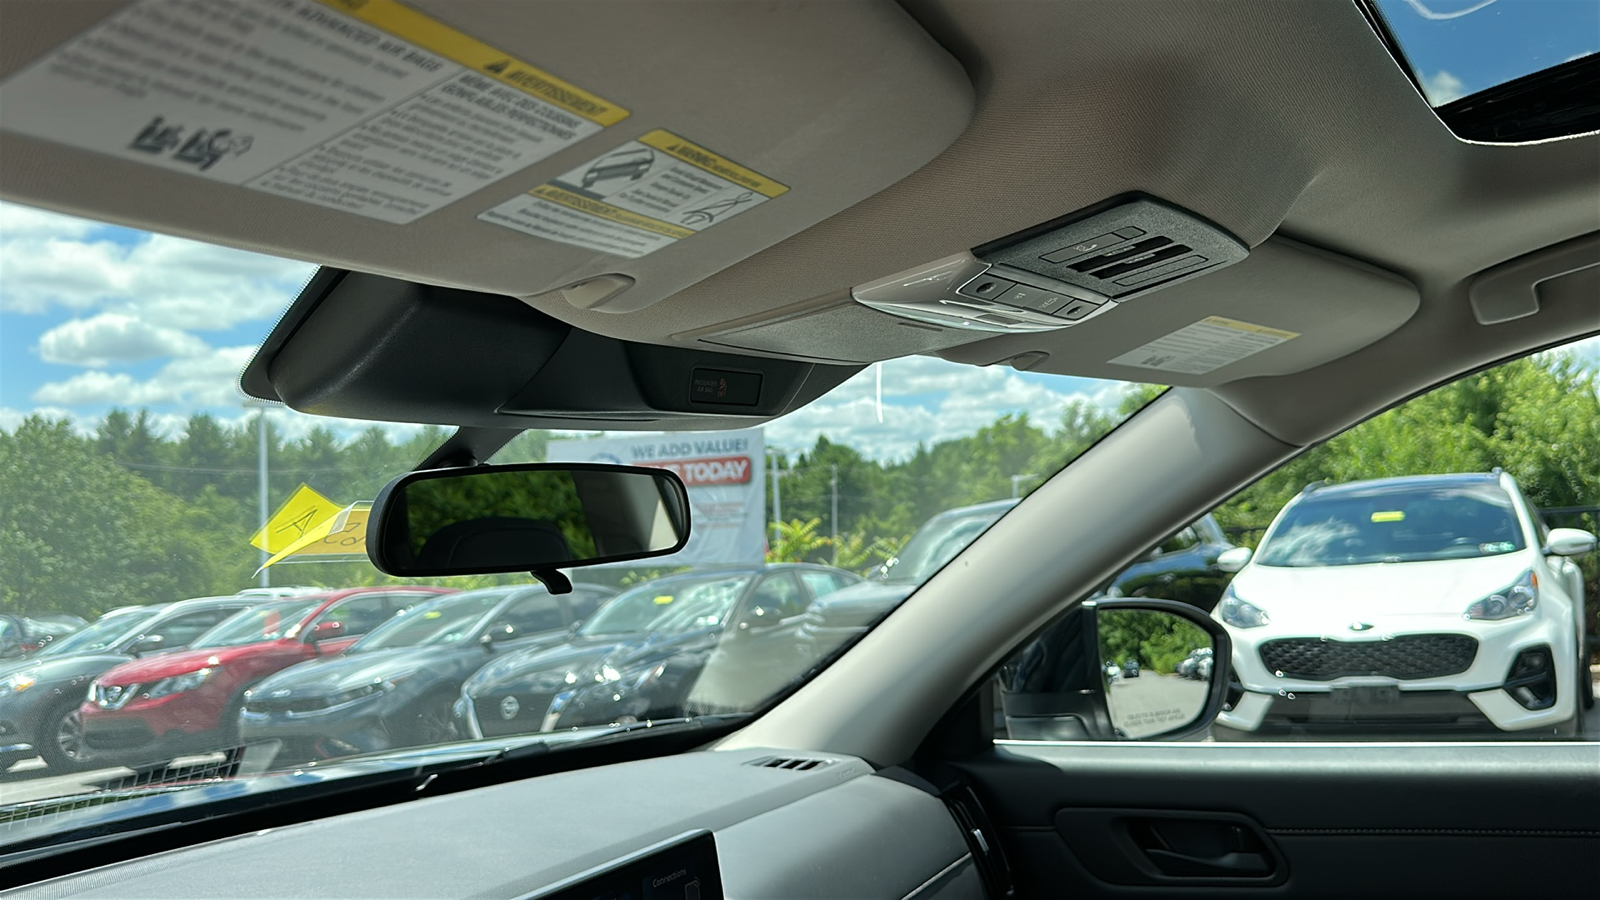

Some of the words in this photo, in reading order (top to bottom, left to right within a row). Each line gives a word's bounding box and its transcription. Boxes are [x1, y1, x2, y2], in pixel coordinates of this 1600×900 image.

[631, 444, 655, 459] WE
[658, 441, 691, 458] ADD
[693, 438, 749, 454] VALUE!
[685, 460, 748, 482] TODAY
[652, 868, 687, 888] Connections
